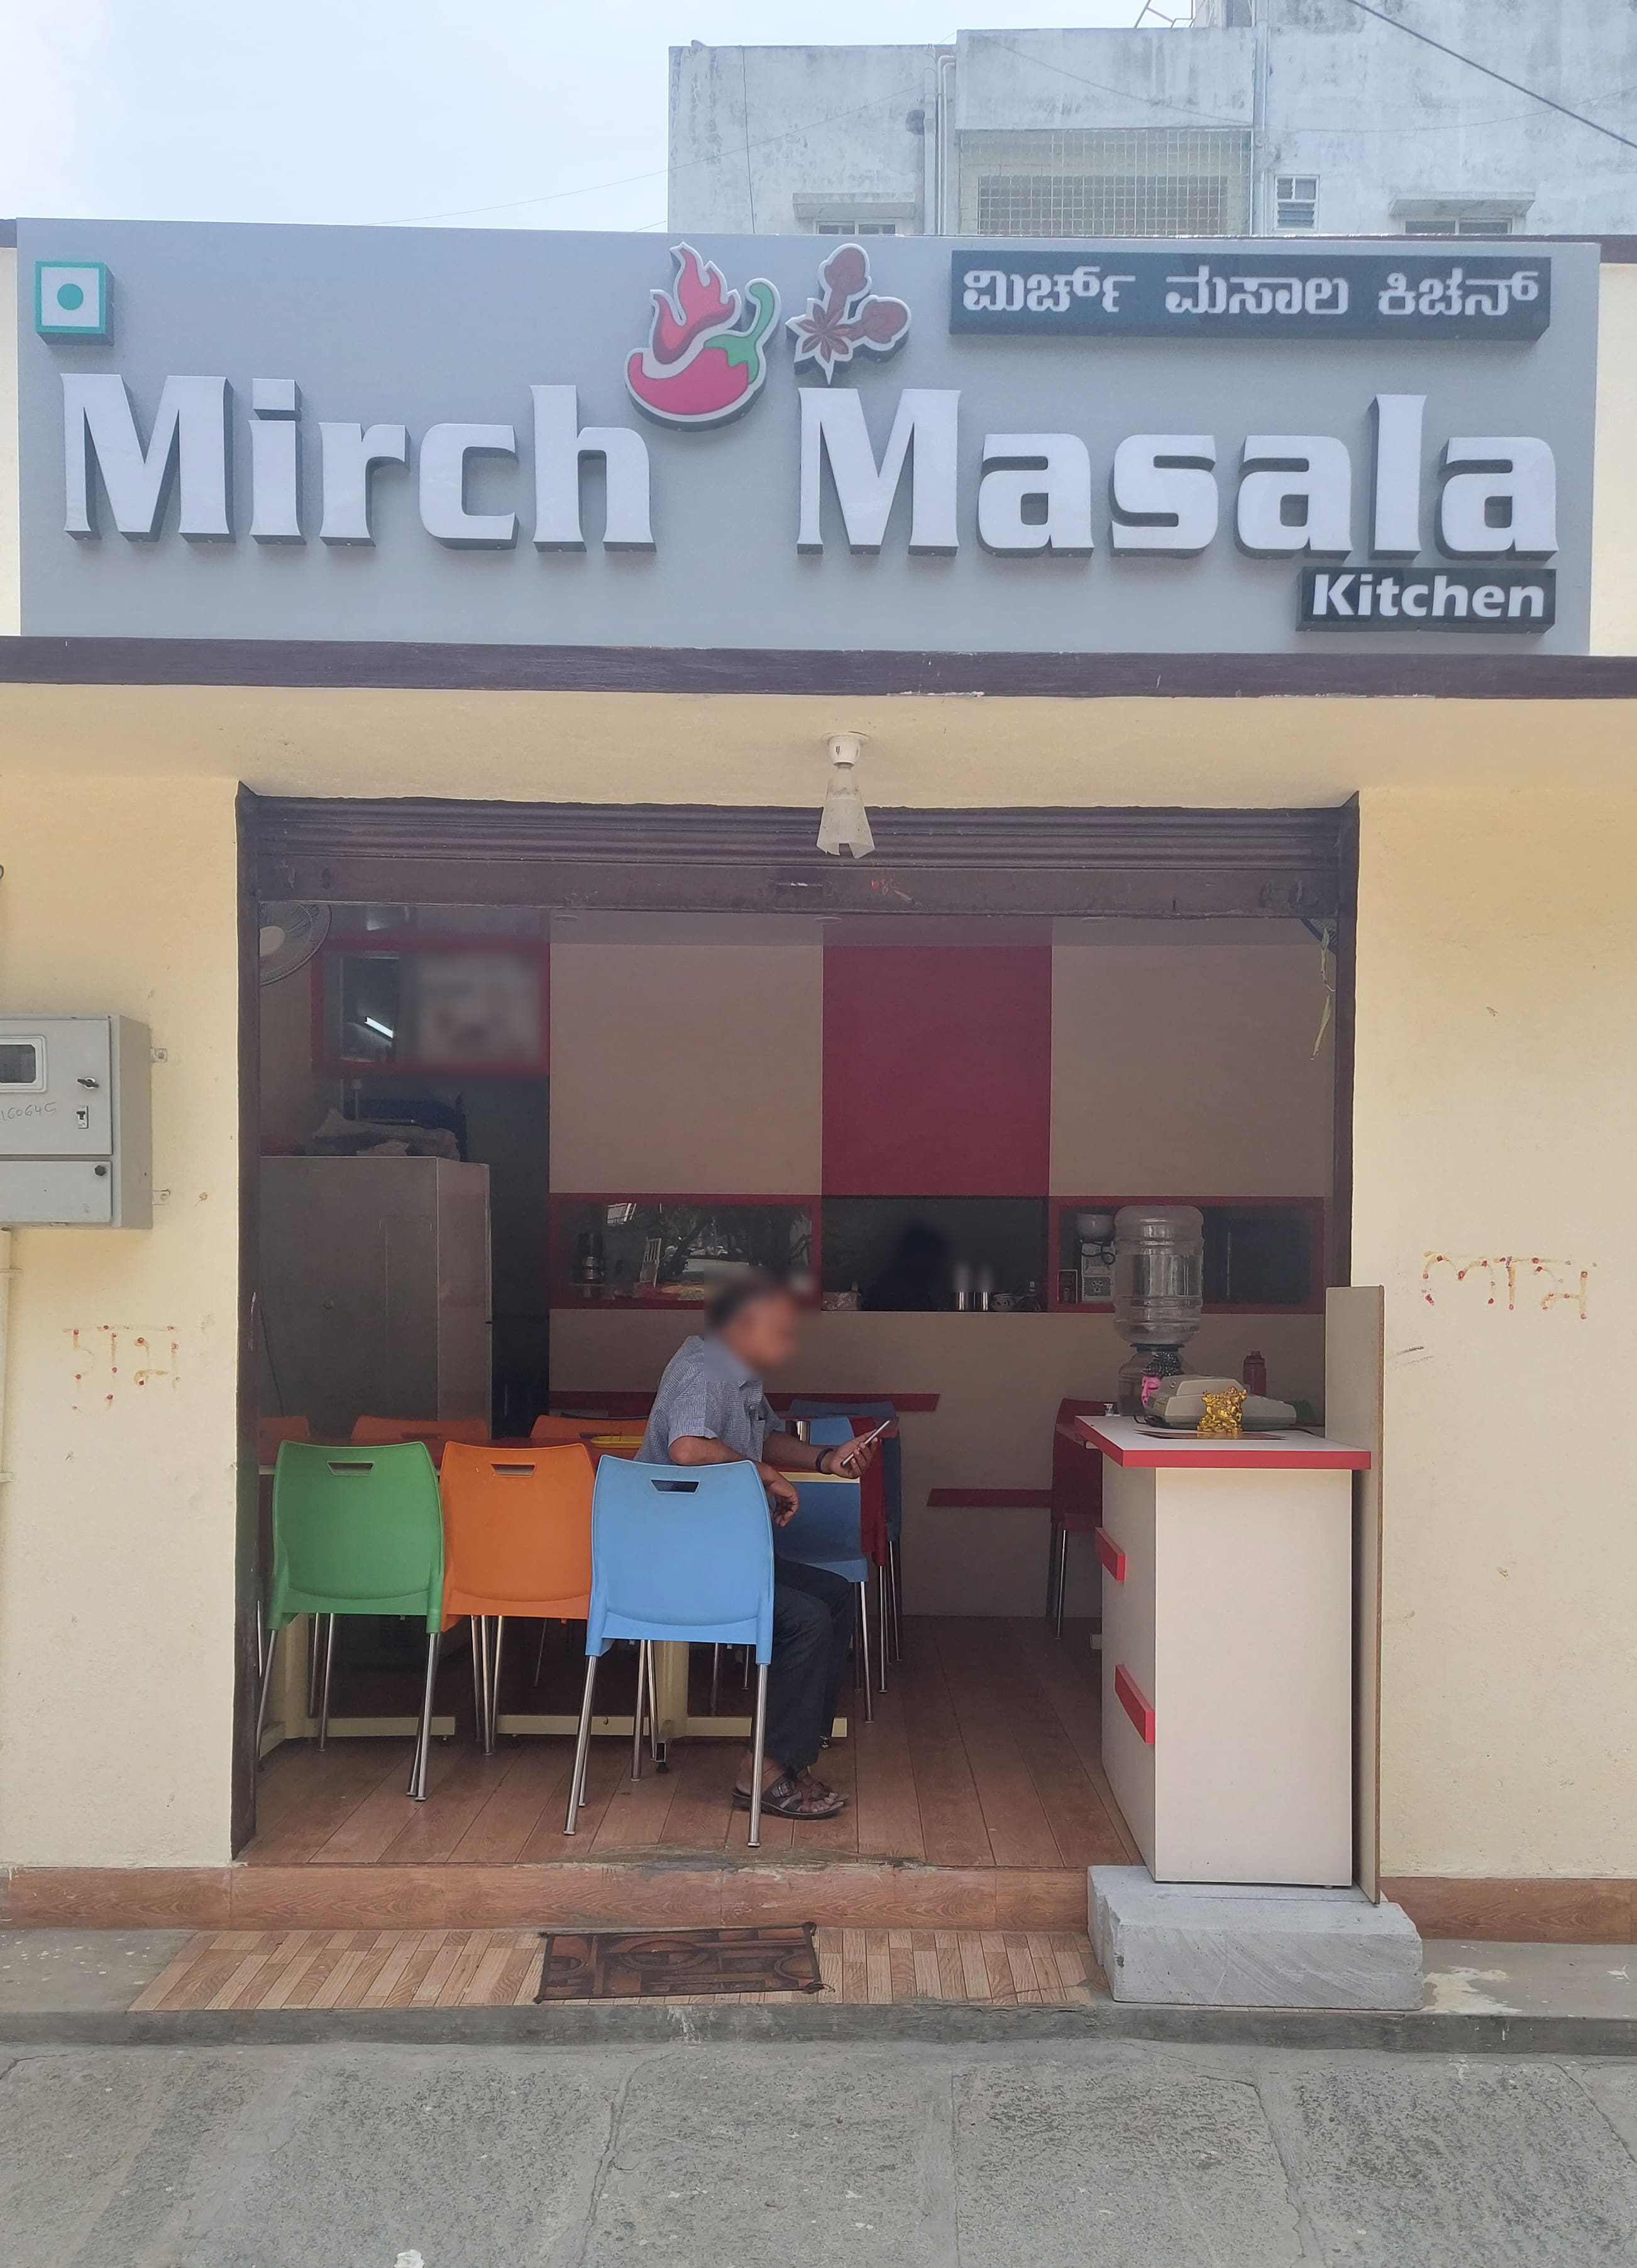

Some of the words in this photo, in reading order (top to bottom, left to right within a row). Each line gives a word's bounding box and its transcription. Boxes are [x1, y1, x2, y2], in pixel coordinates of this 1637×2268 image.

[1164, 264, 1349, 315] ಮಸಾಲ
[1377, 267, 1539, 316] ಕಿಚನ್
[60, 373, 656, 551] Mirch
[795, 387, 1558, 561] Masala
[1311, 573, 1545, 618] Kitchen
